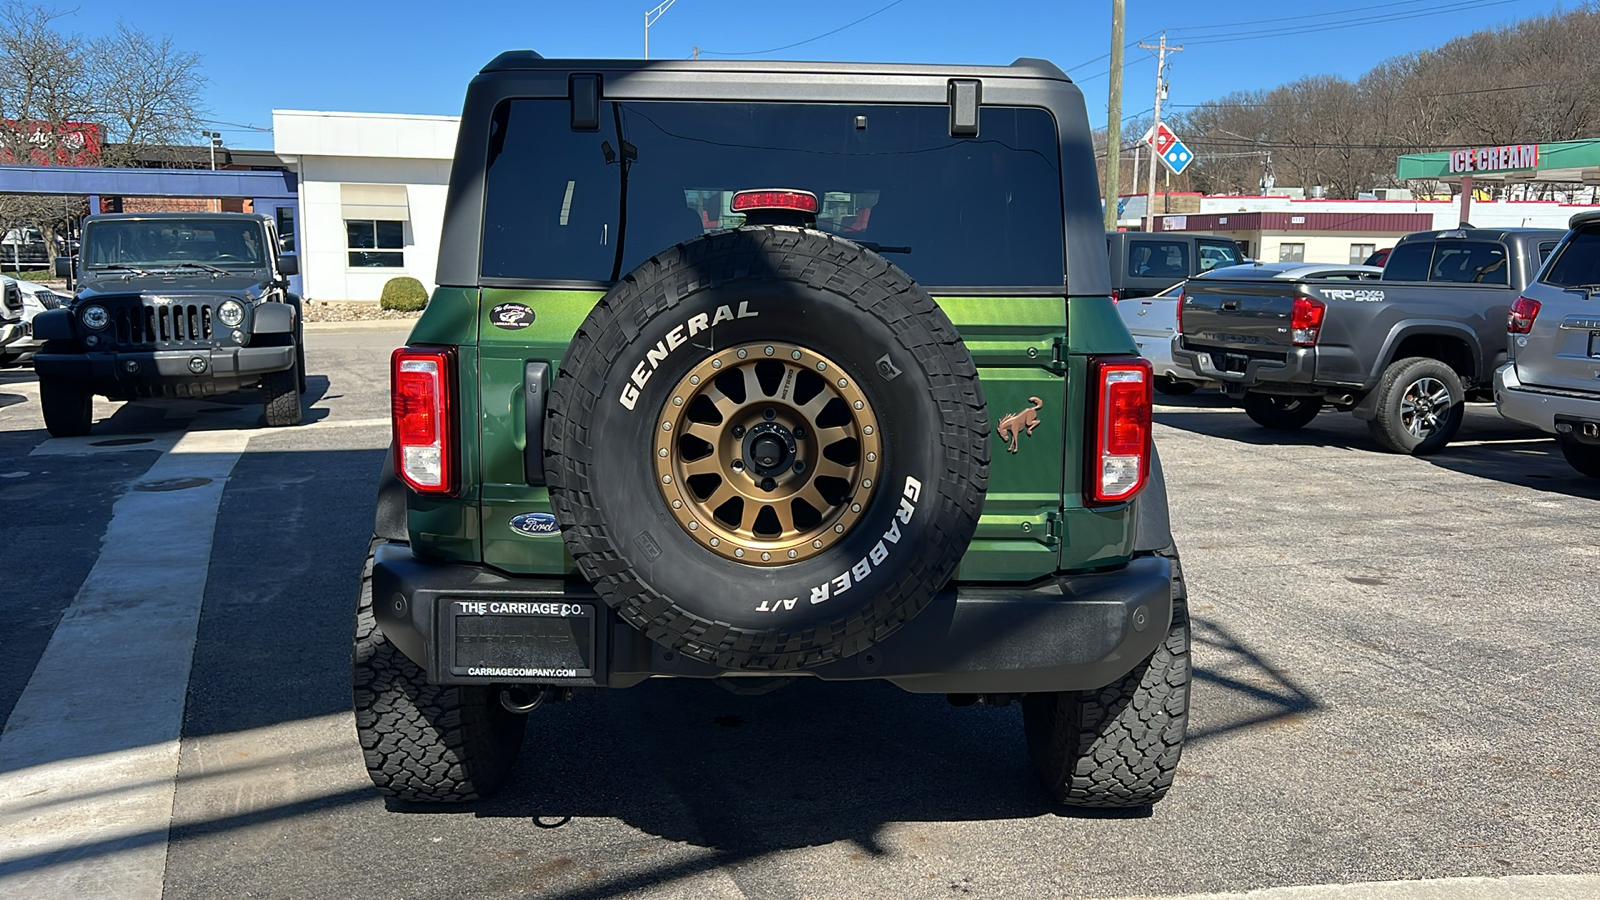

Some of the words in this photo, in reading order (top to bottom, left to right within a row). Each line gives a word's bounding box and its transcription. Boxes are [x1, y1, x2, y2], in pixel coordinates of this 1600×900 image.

[1449, 149, 1476, 173] ICE
[1477, 145, 1538, 171] CREAM
[619, 300, 759, 411] GENERAL
[527, 517, 560, 532] Ford
[810, 475, 923, 605] GRABBER
[460, 602, 487, 615] THE
[489, 603, 559, 615] CARRIAGE
[561, 604, 585, 616] CO.
[755, 597, 799, 612] A/T
[468, 667, 577, 678] CARRIAGECOMPANY.COM
